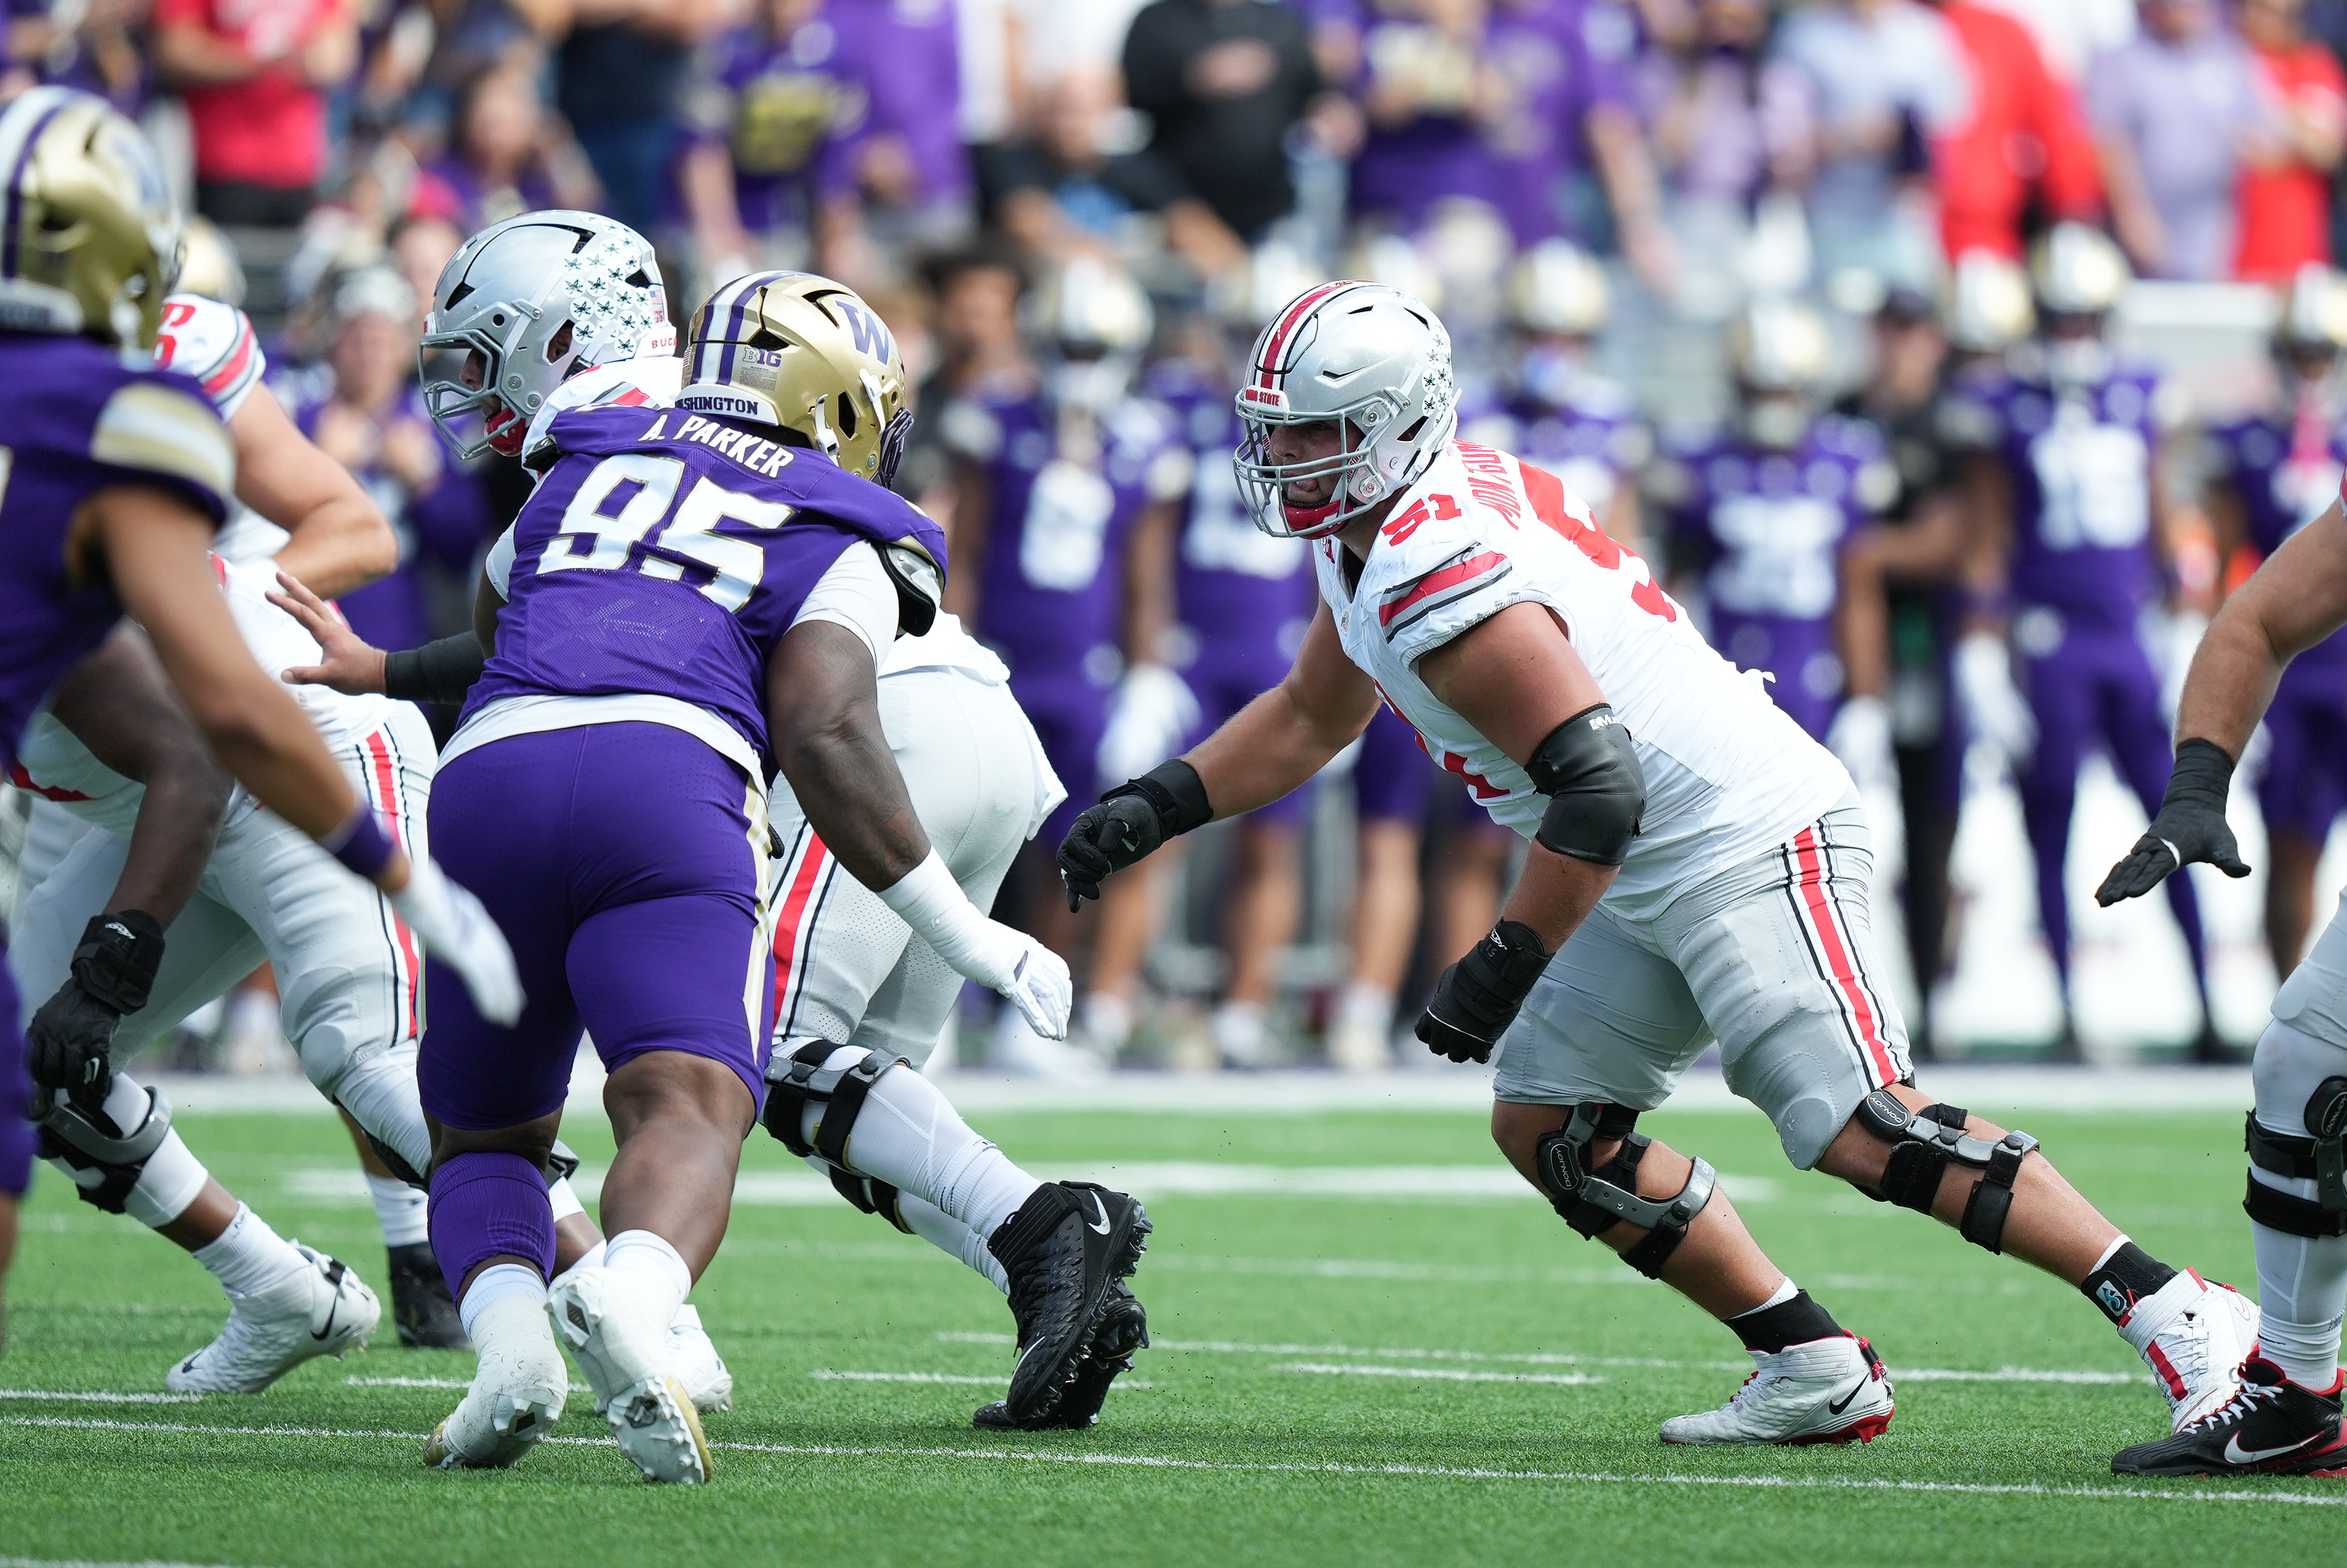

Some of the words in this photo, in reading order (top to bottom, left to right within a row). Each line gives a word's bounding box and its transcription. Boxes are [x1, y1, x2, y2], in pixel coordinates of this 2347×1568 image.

[652, 337, 678, 348] BUC
[833, 299, 890, 367] W
[1259, 391, 1280, 406] STATE
[638, 414, 668, 441] A.
[672, 415, 794, 478] PARKER
[535, 454, 797, 613] 95
[1381, 493, 1461, 547] 51
[1869, 1096, 1903, 1123] DONJOY
[1555, 1147, 1572, 1187] DONJOY
